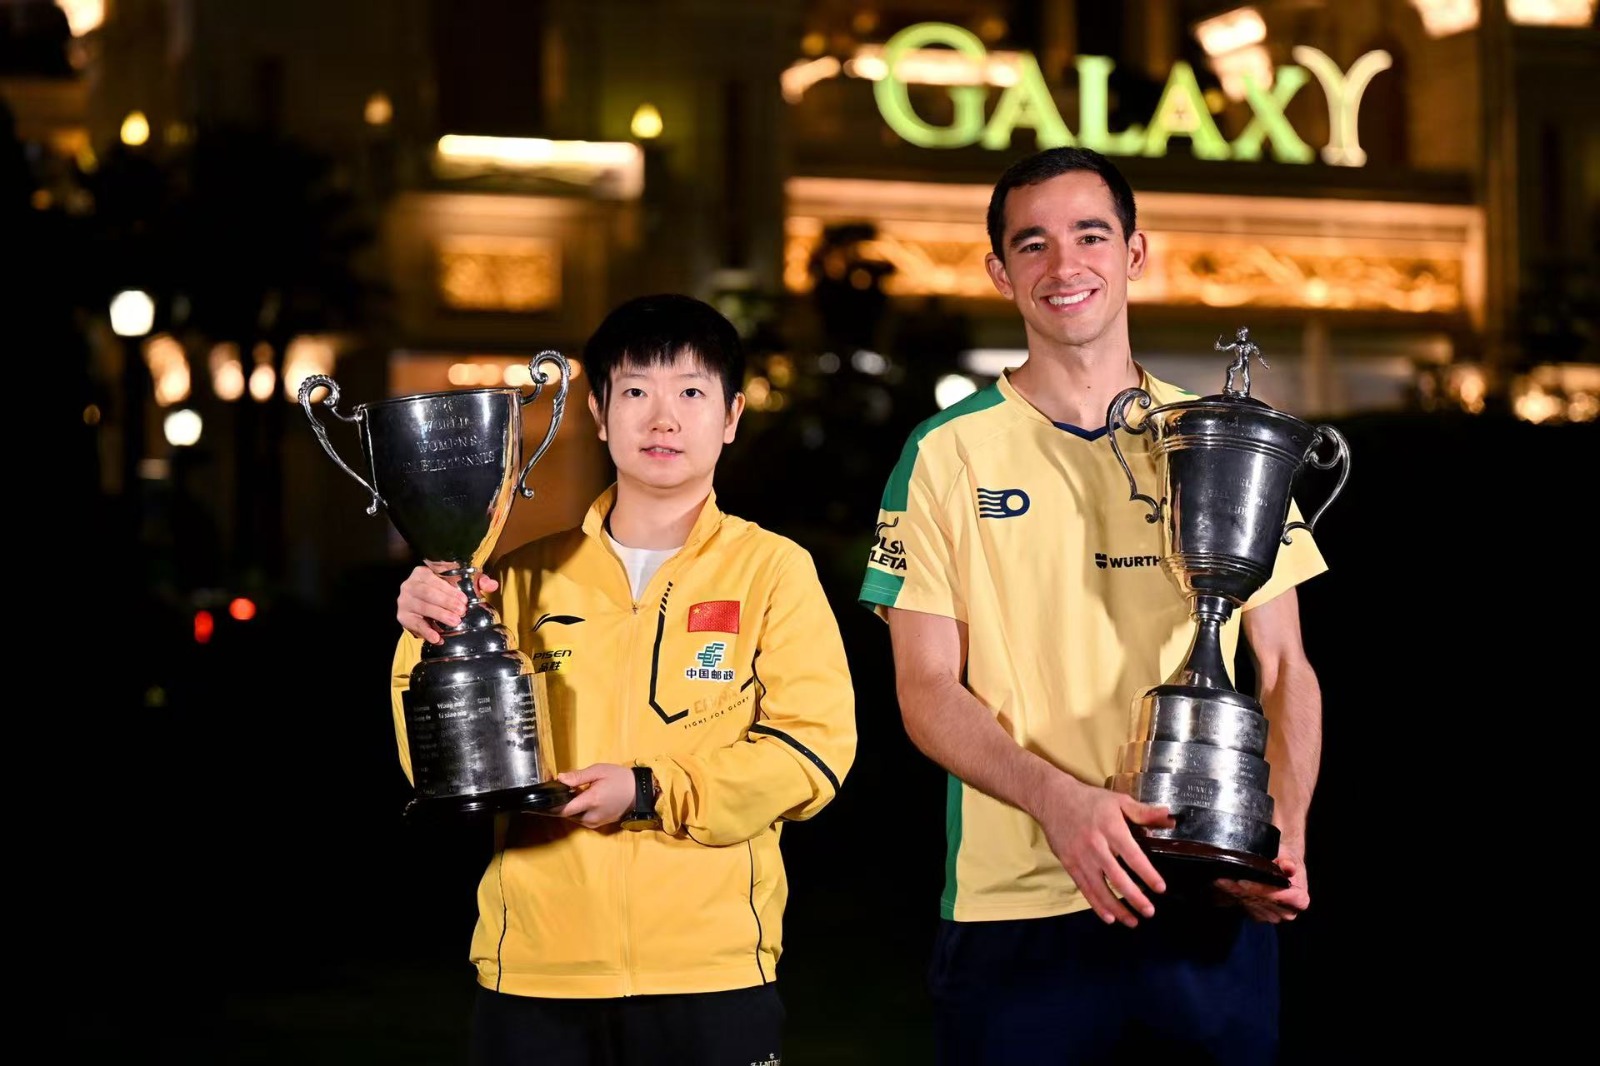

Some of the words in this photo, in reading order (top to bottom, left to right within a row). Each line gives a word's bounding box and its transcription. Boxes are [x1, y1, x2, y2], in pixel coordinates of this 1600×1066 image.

[873, 22, 1393, 168] GALAXY
[533, 649, 572, 661] PISEN
[686, 667, 734, 681] 中国邮政
[684, 717, 708, 730] FIGHT
[710, 709, 725, 720] FOR
[727, 696, 750, 712] GLORY
